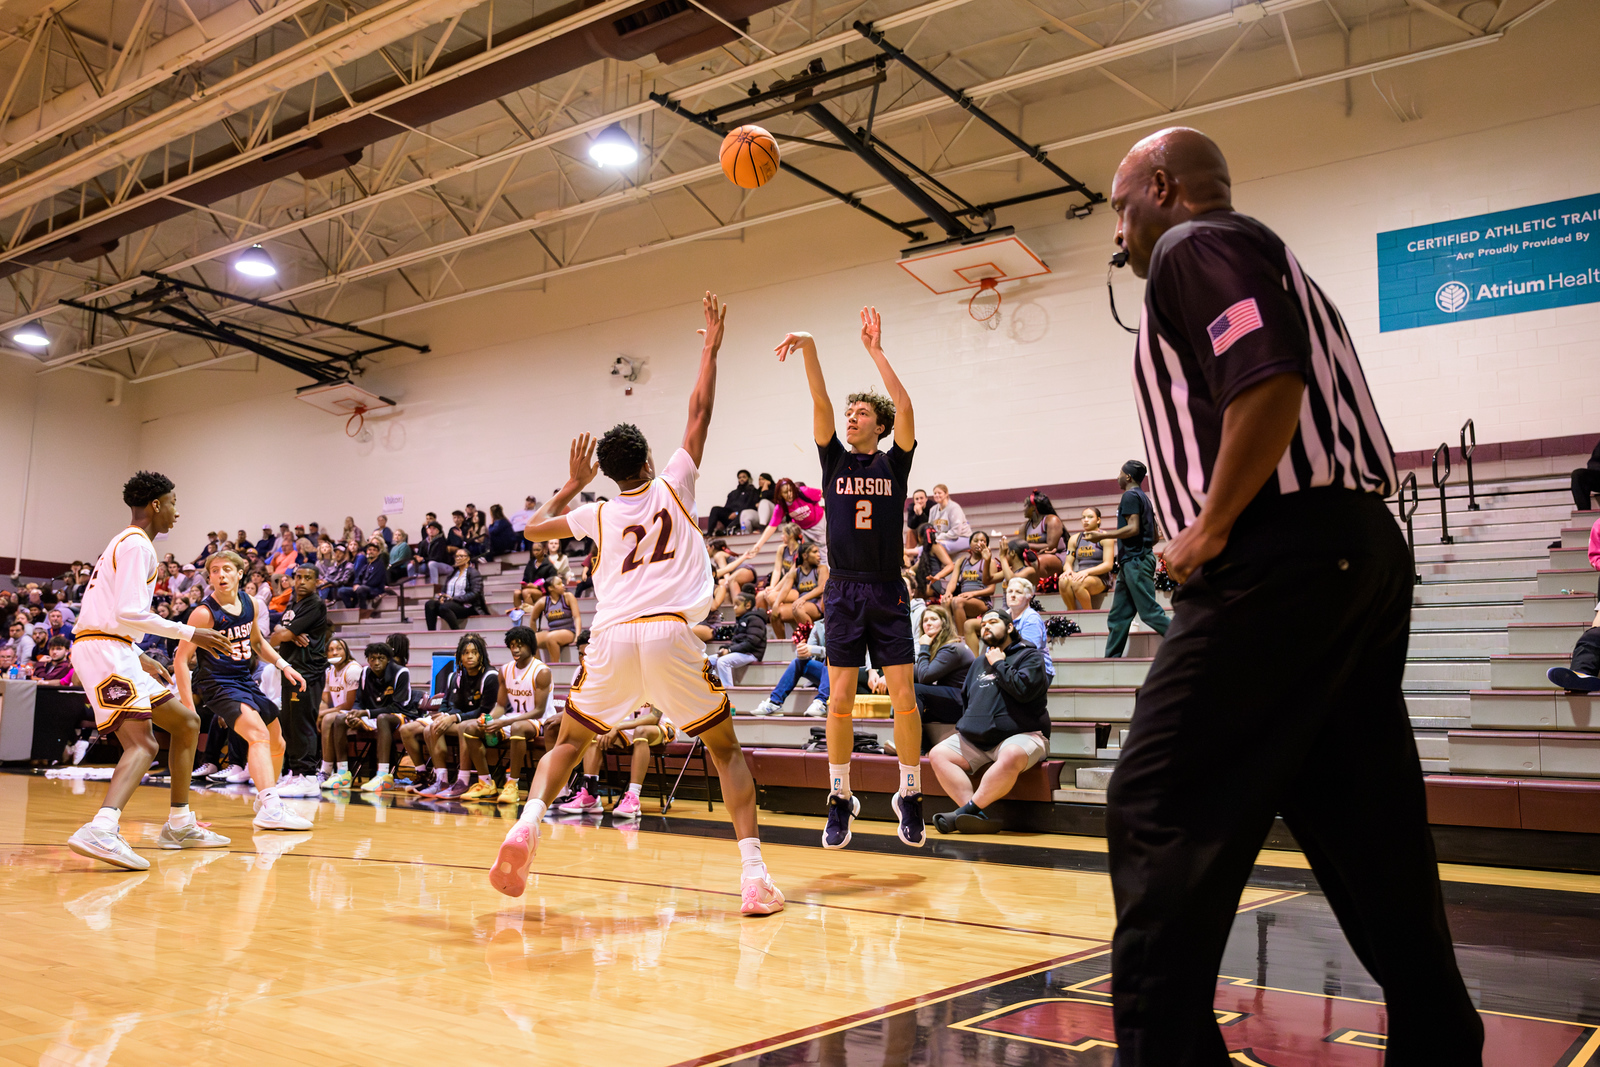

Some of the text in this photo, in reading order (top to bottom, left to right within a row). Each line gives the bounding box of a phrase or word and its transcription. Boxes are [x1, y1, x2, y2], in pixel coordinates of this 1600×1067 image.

[1407, 208, 1600, 252] CERTIFIED ATHLETIC TRAI
[1456, 231, 1590, 261] Are Proudly Provided By
[1476, 279, 1545, 300] Atrium
[836, 477, 892, 496] CARSON
[855, 500, 872, 530] 2
[621, 507, 676, 575] 22
[219, 621, 253, 641] ARSO
[230, 638, 252, 661] 55
